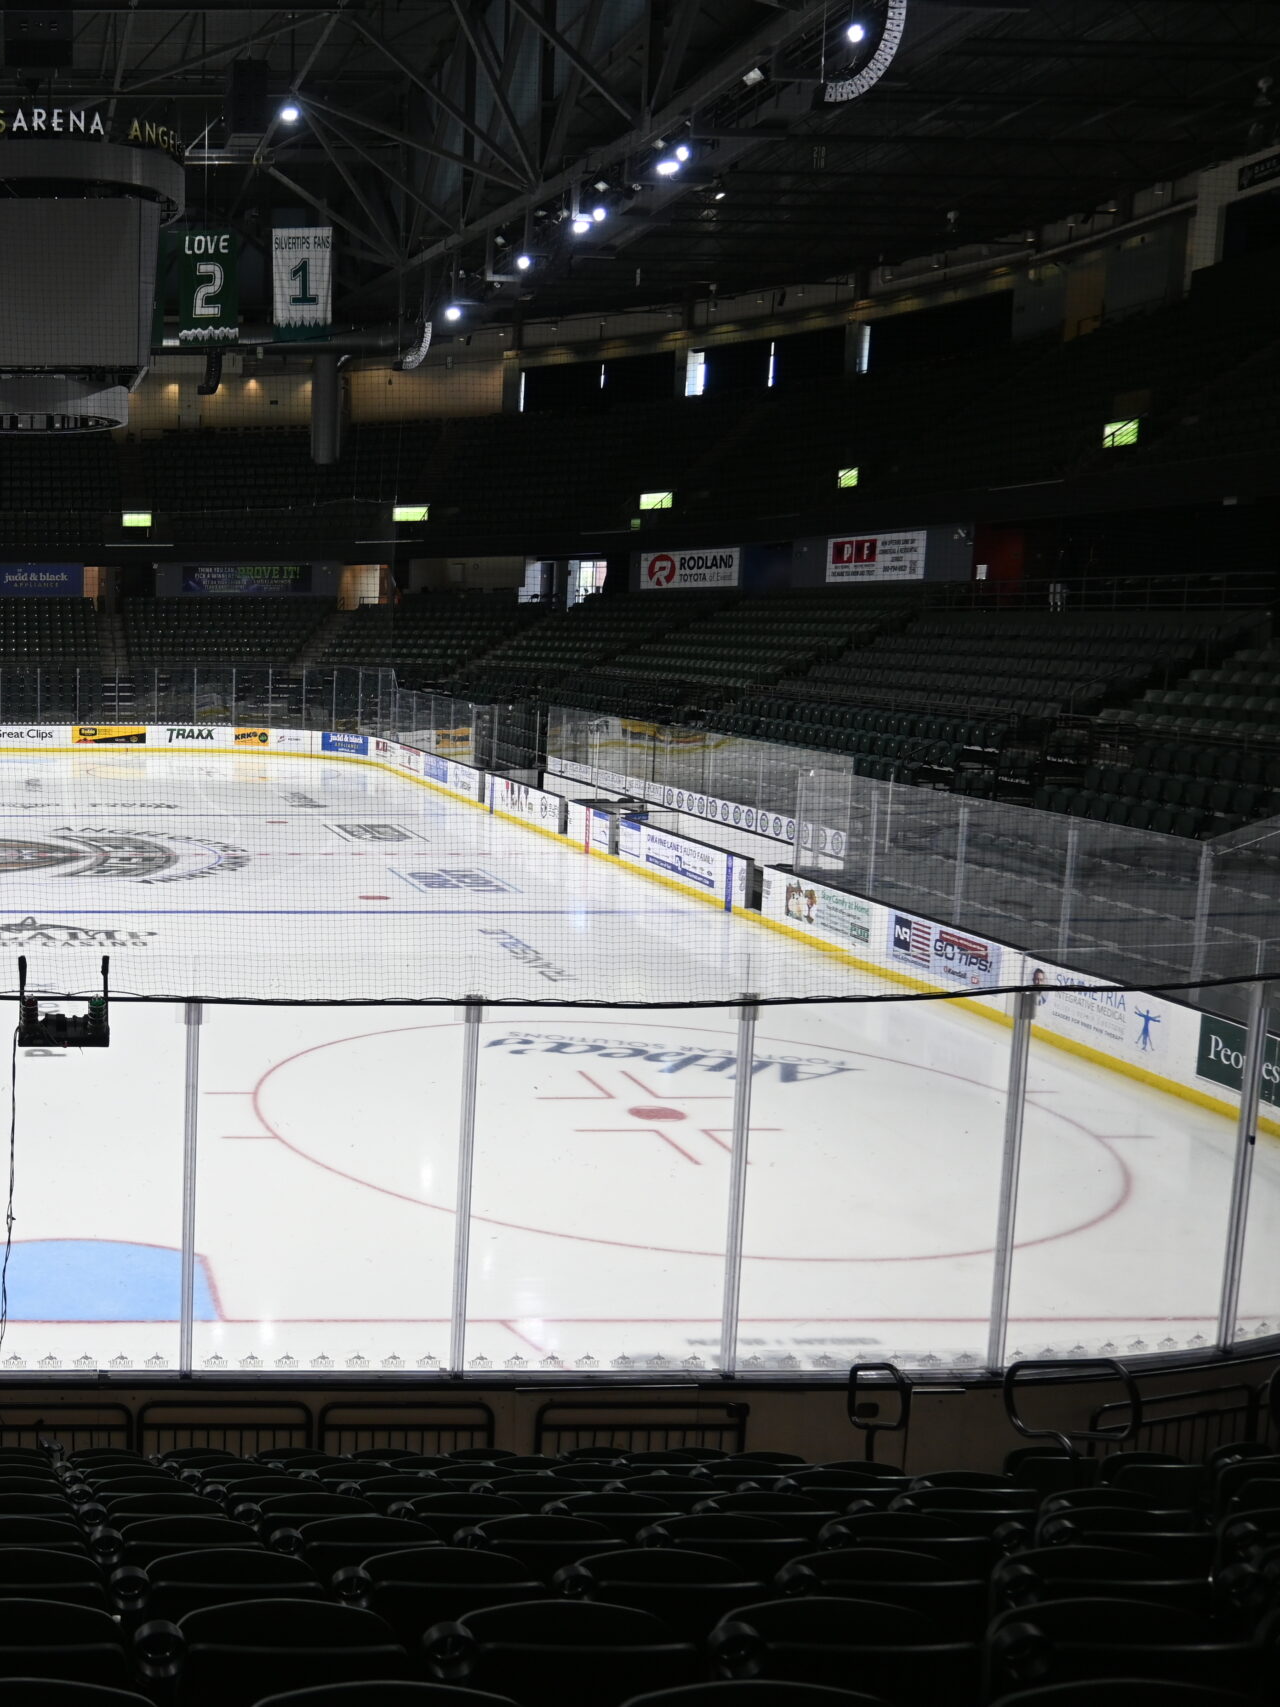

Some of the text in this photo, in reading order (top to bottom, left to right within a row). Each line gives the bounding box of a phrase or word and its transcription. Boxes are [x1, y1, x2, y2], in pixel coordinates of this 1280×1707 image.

[12, 107, 105, 136] ARENA
[184, 234, 230, 255] LOVE
[274, 235, 331, 250] SILVERTIPS FANS
[192, 261, 225, 318] 2
[290, 257, 319, 305] 1
[679, 554, 734, 571] RODLAND
[29, 573, 39, 582] &
[40, 572, 69, 582] black
[679, 573, 707, 582] TOYOTA
[26, 728, 53, 740] Clips
[166, 728, 216, 743] TRAXX
[933, 938, 955, 961] GO
[956, 946, 993, 973] TIPS!
[1096, 1004, 1127, 1024] MEDICAL
[508, 1030, 666, 1049] SOLUTIONS
[1207, 1033, 1280, 1084] Peoes
